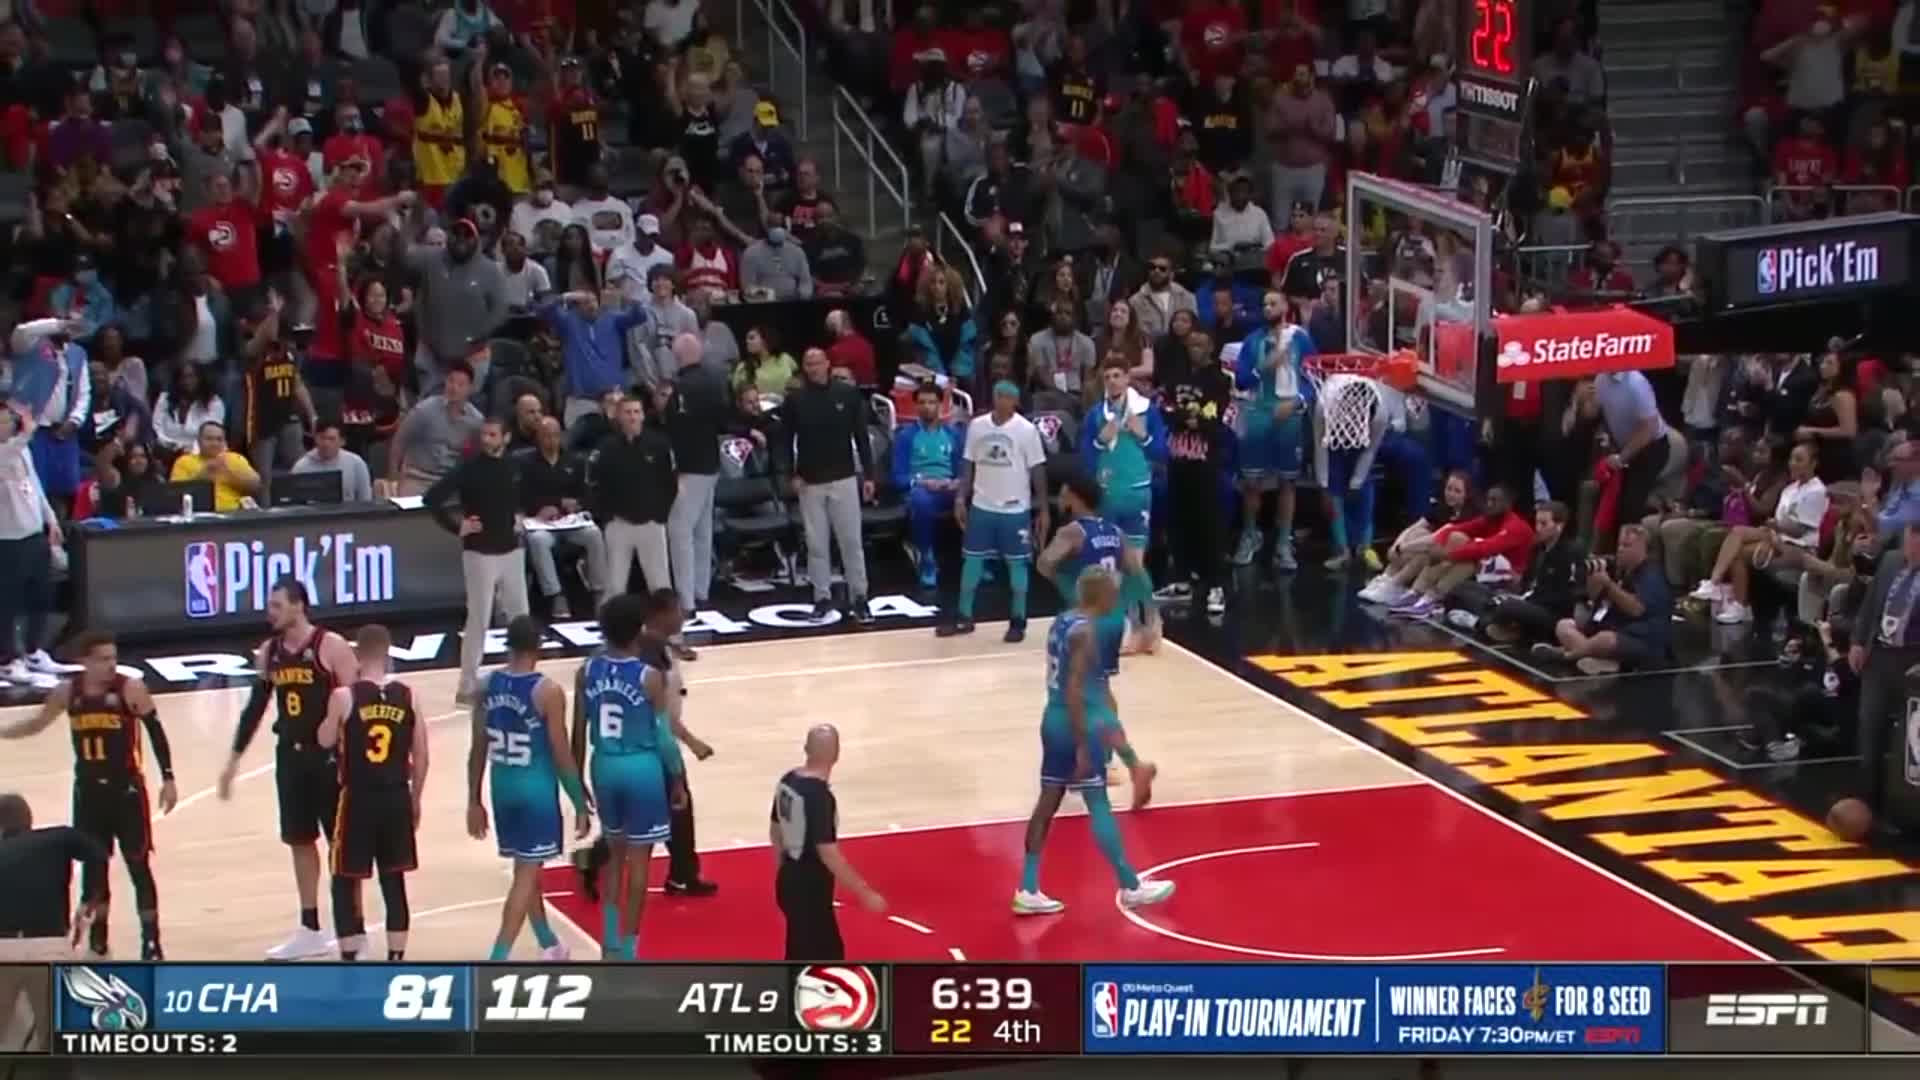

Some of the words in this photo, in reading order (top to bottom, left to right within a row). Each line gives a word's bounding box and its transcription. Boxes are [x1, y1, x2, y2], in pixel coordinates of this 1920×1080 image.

[1471, 0, 1512, 72] 22
[1780, 241, 1878, 291] Pick'Em
[224, 533, 394, 613] Pick'Em
[286, 690, 301, 717] 8
[600, 702, 624, 739] 6
[82, 735, 106, 761] 11
[366, 724, 392, 763] 3
[485, 727, 531, 767] 25
[1245, 651, 1917, 902] ATLANTA
